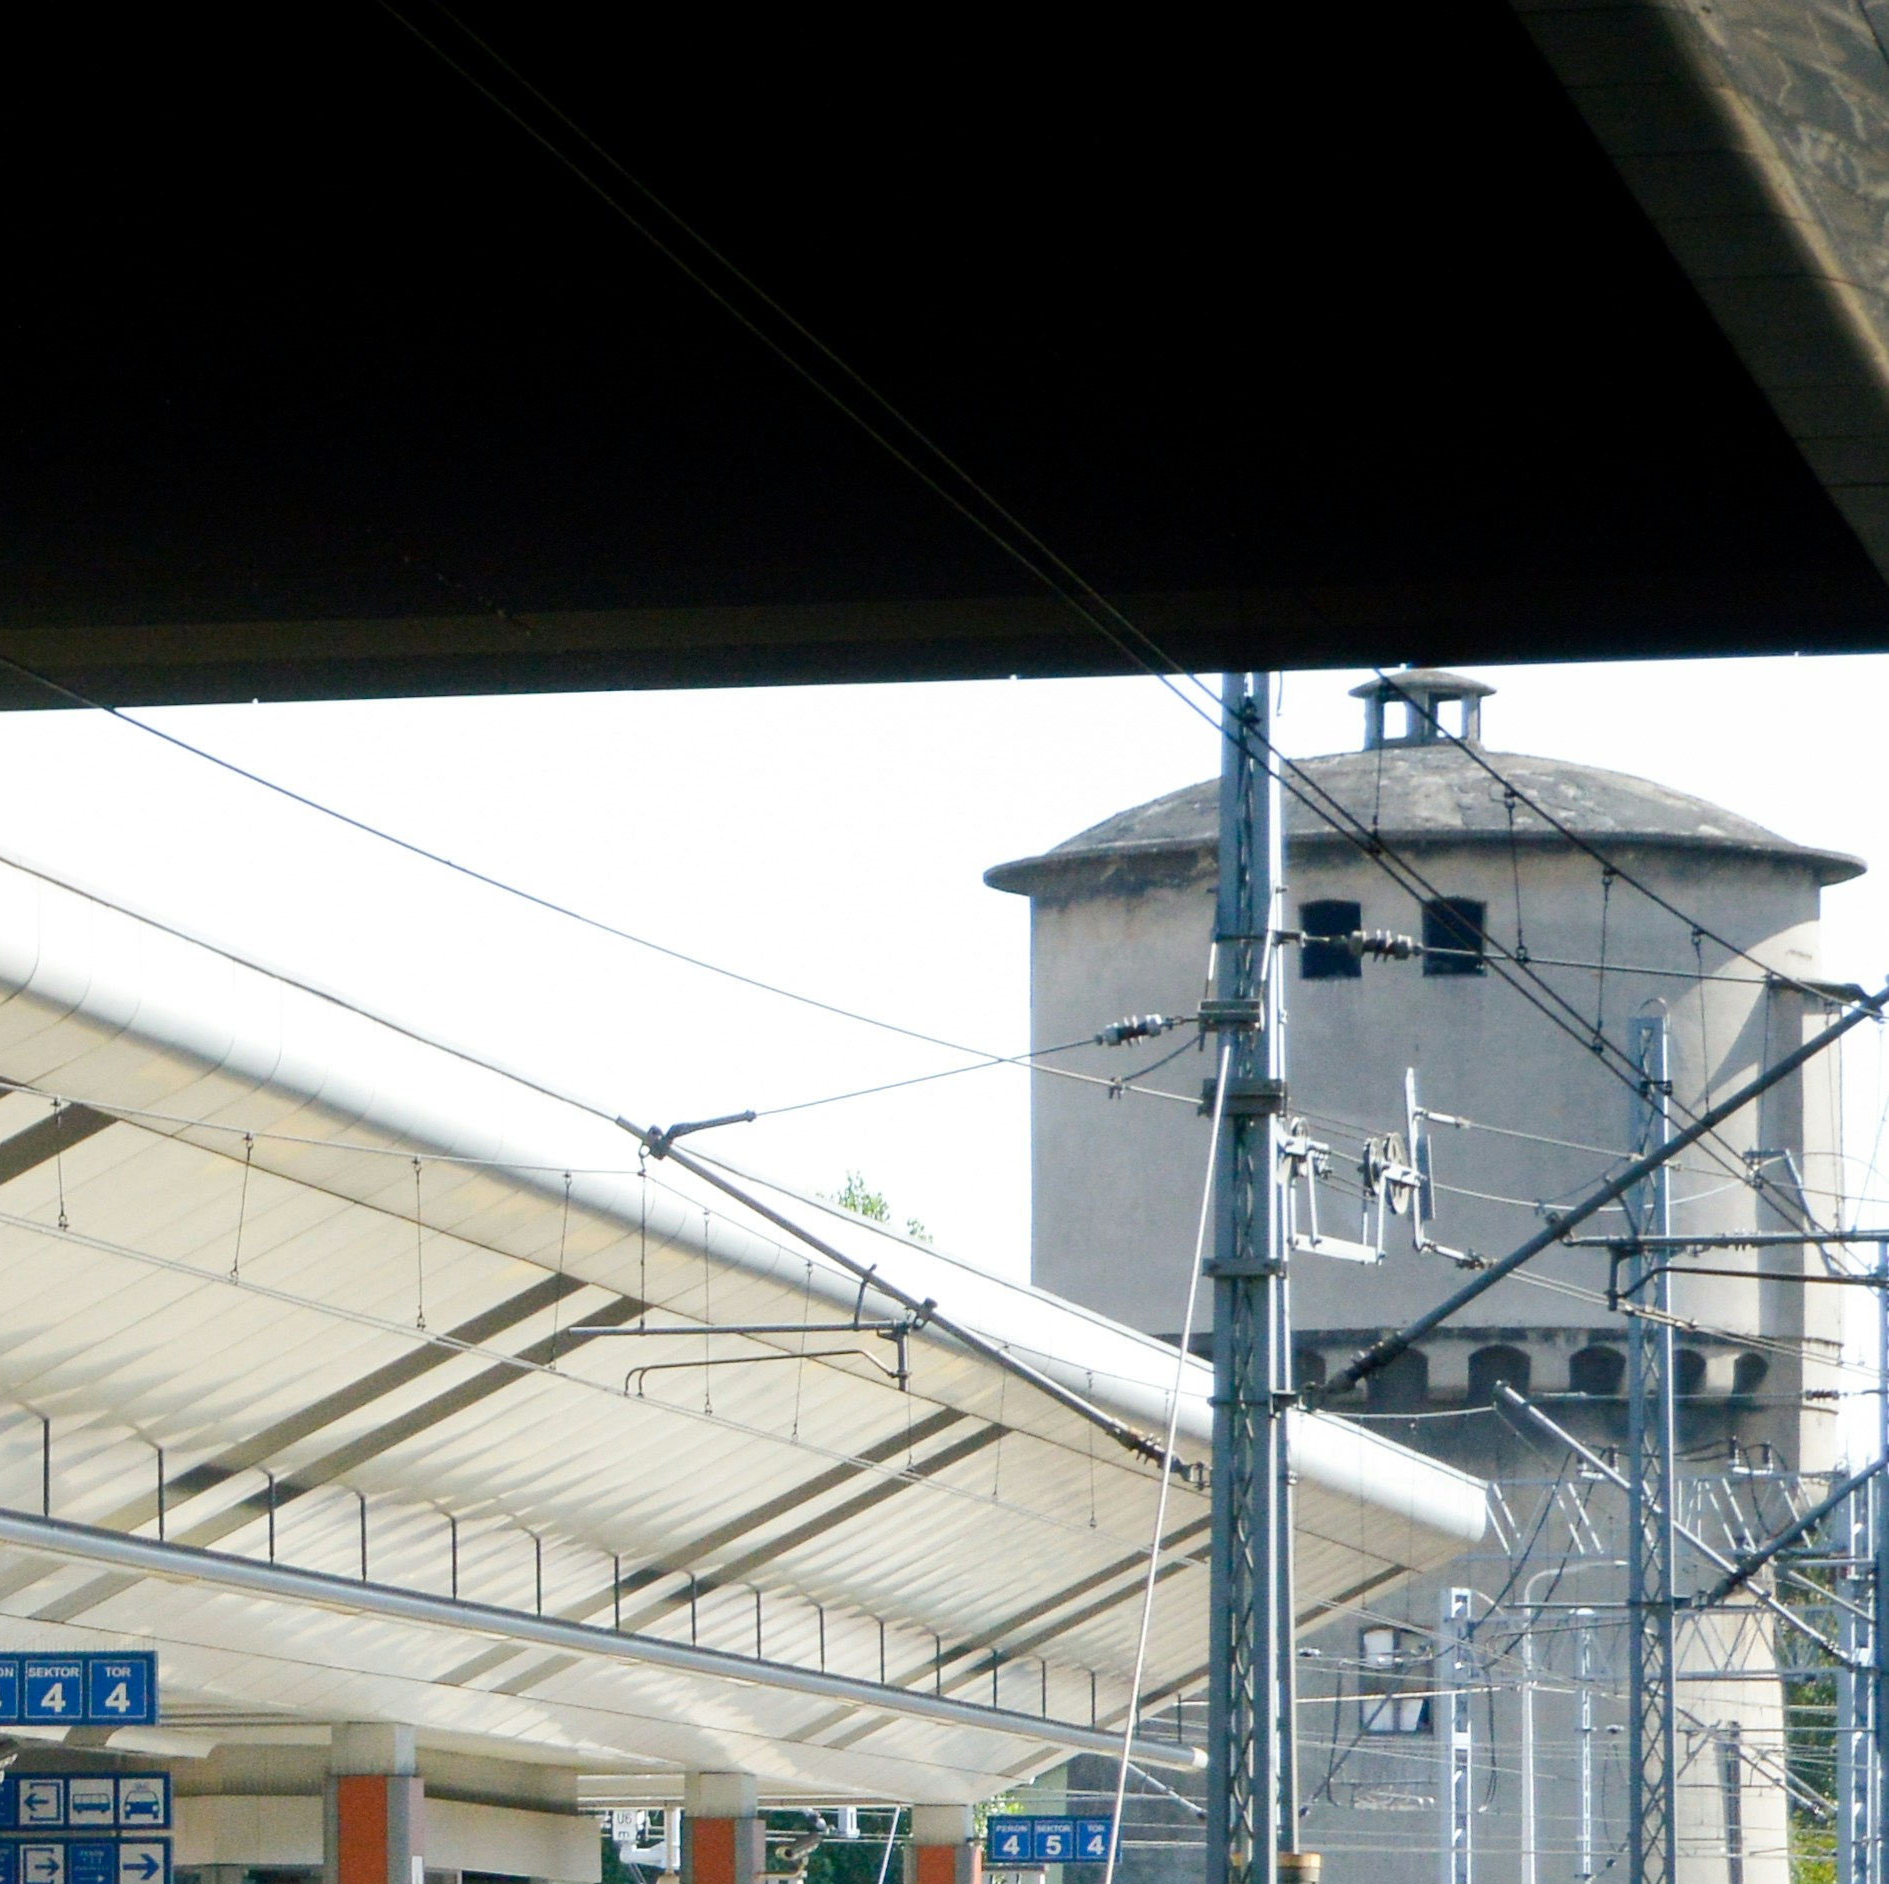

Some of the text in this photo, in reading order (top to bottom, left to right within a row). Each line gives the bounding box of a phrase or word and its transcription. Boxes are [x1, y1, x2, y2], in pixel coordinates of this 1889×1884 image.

[28, 1666, 80, 1678] SEKTOR
[104, 1666, 132, 1678] TOR
[40, 1682, 66, 1713] 4
[104, 1682, 130, 1713] 4
[995, 1824, 1105, 1833] PERON SEKTOR TOR
[1002, 1834, 1105, 1855] 4 5 4
